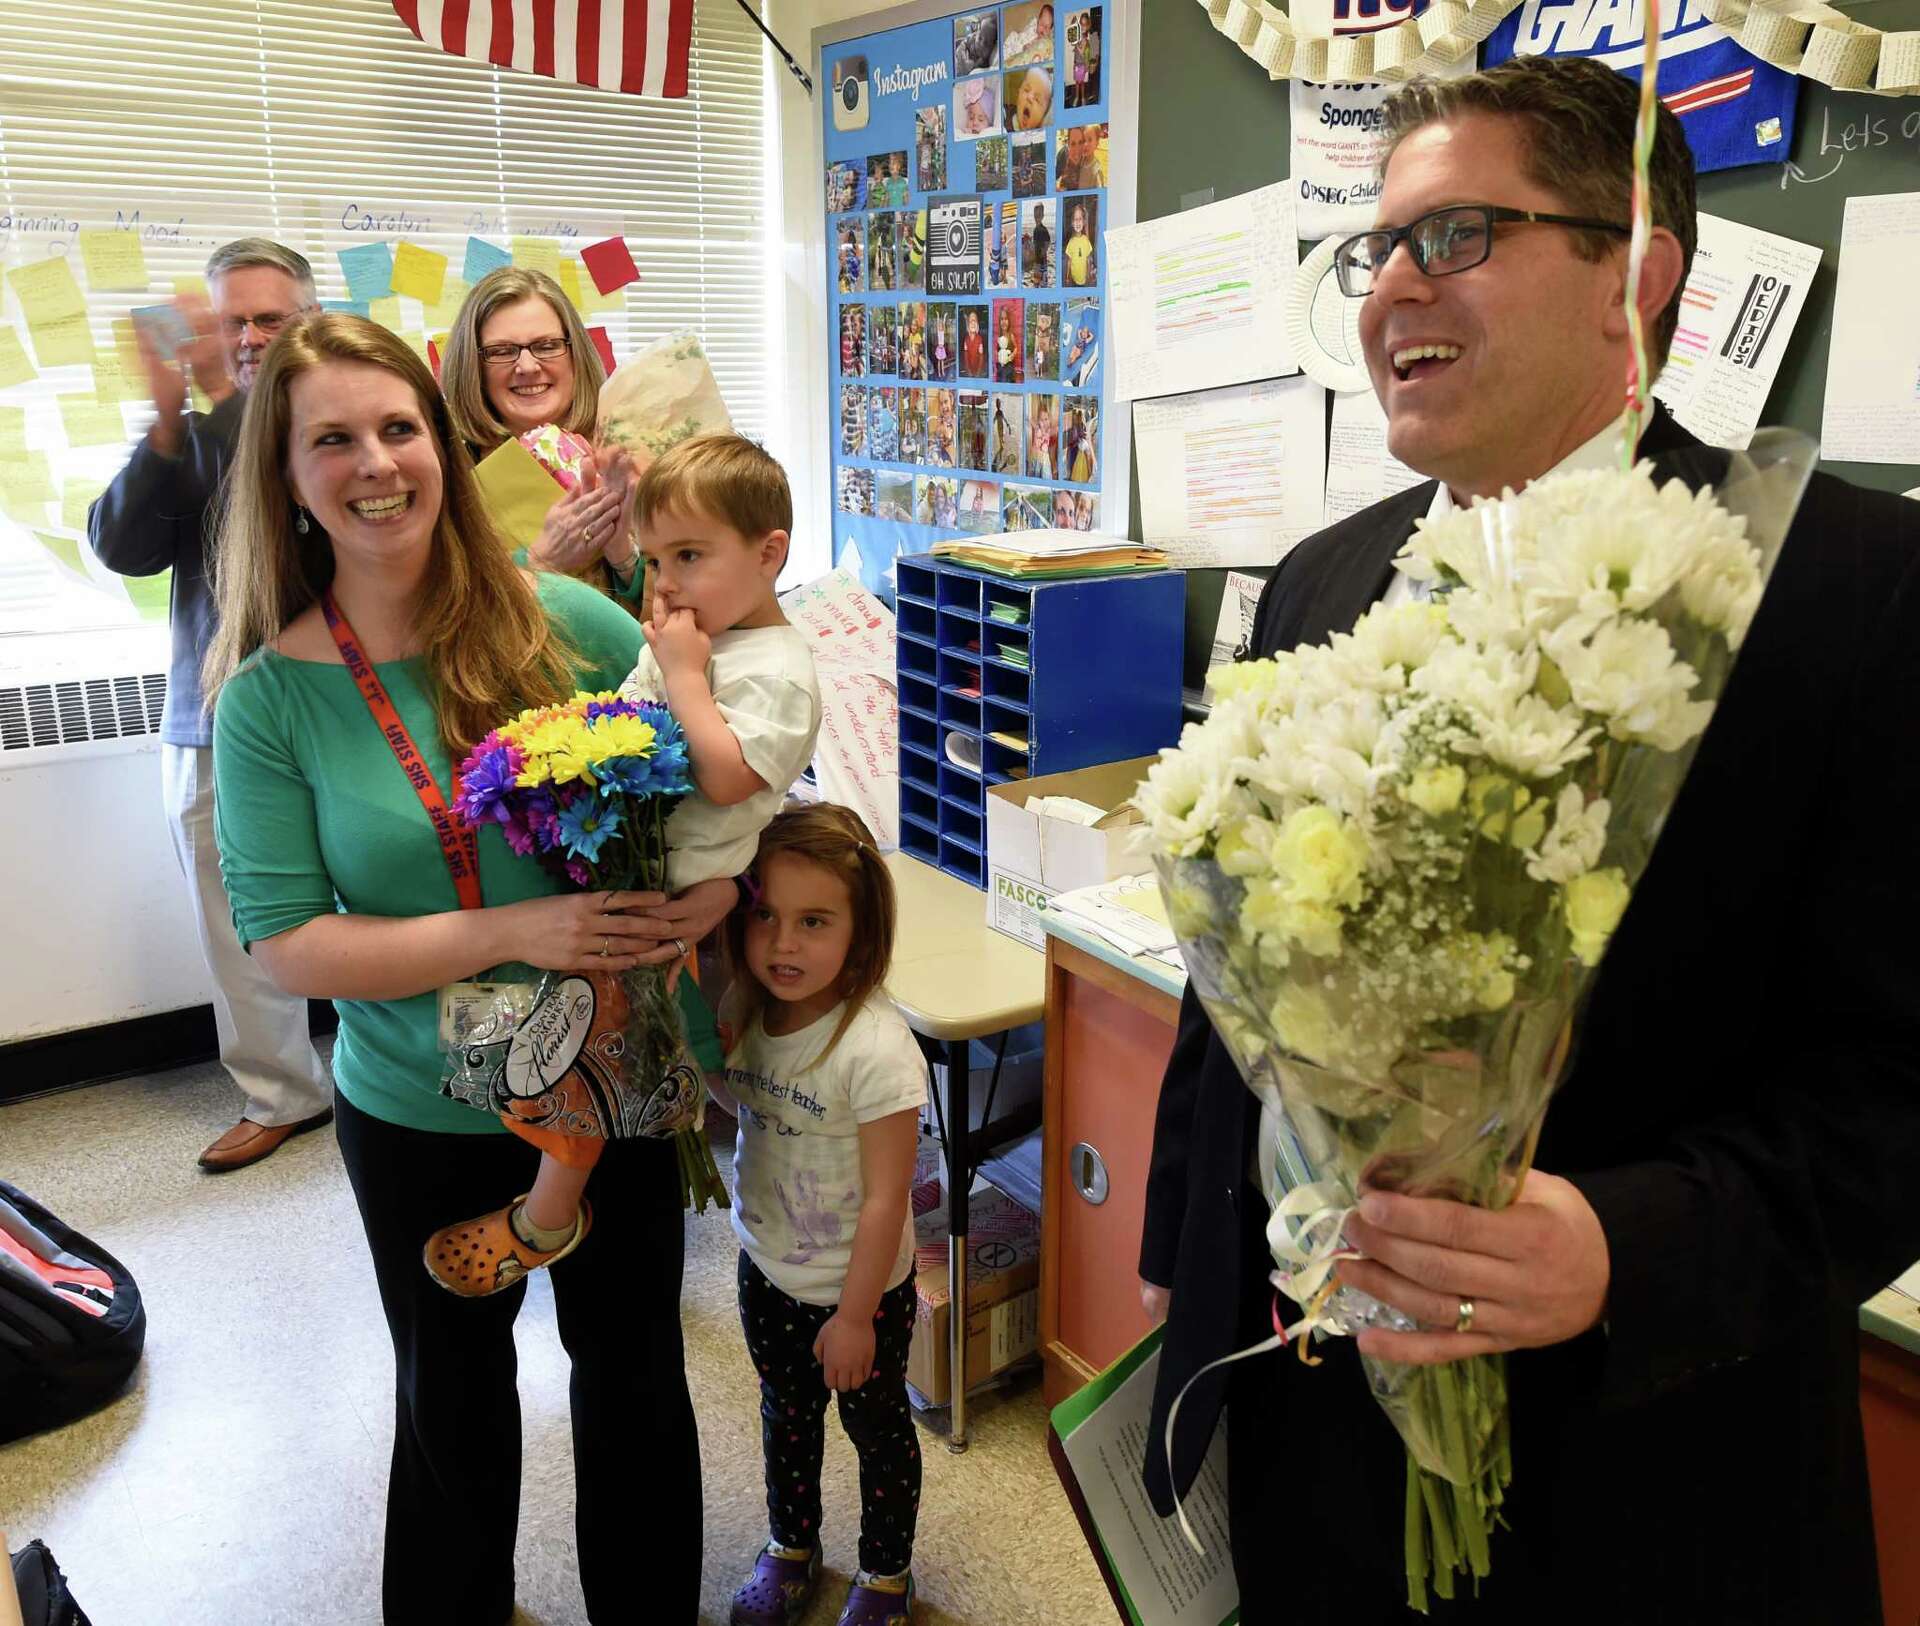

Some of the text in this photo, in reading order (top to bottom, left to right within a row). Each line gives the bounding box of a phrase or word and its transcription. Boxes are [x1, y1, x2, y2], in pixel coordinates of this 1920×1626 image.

[874, 60, 948, 102] Instagram
[1820, 105, 1889, 155] Lets
[931, 271, 944, 290] OH
[1733, 276, 1778, 365] OEDIPUS
[845, 702, 888, 778] understand
[405, 761, 432, 791] SHS
[429, 806, 457, 848] STAFF
[449, 848, 468, 880] SHS
[998, 877, 1047, 911] FASCO
[768, 1069, 790, 1098] best
